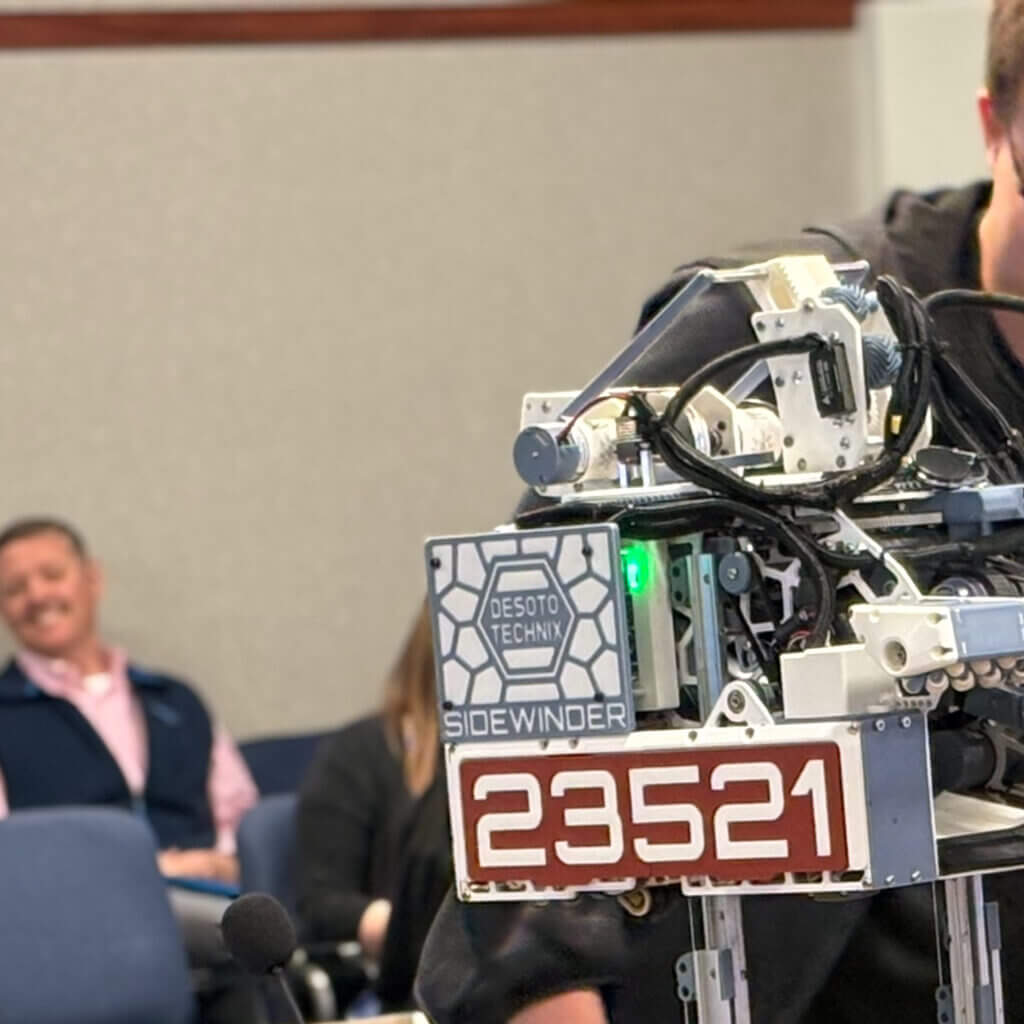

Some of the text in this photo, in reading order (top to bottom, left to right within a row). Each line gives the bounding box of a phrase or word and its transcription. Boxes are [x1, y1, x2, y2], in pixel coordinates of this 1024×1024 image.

[490, 594, 559, 619] DESOTO
[491, 621, 562, 645] TECHNIX
[443, 702, 627, 737] SIDEWINDER
[473, 758, 832, 868] 23521
